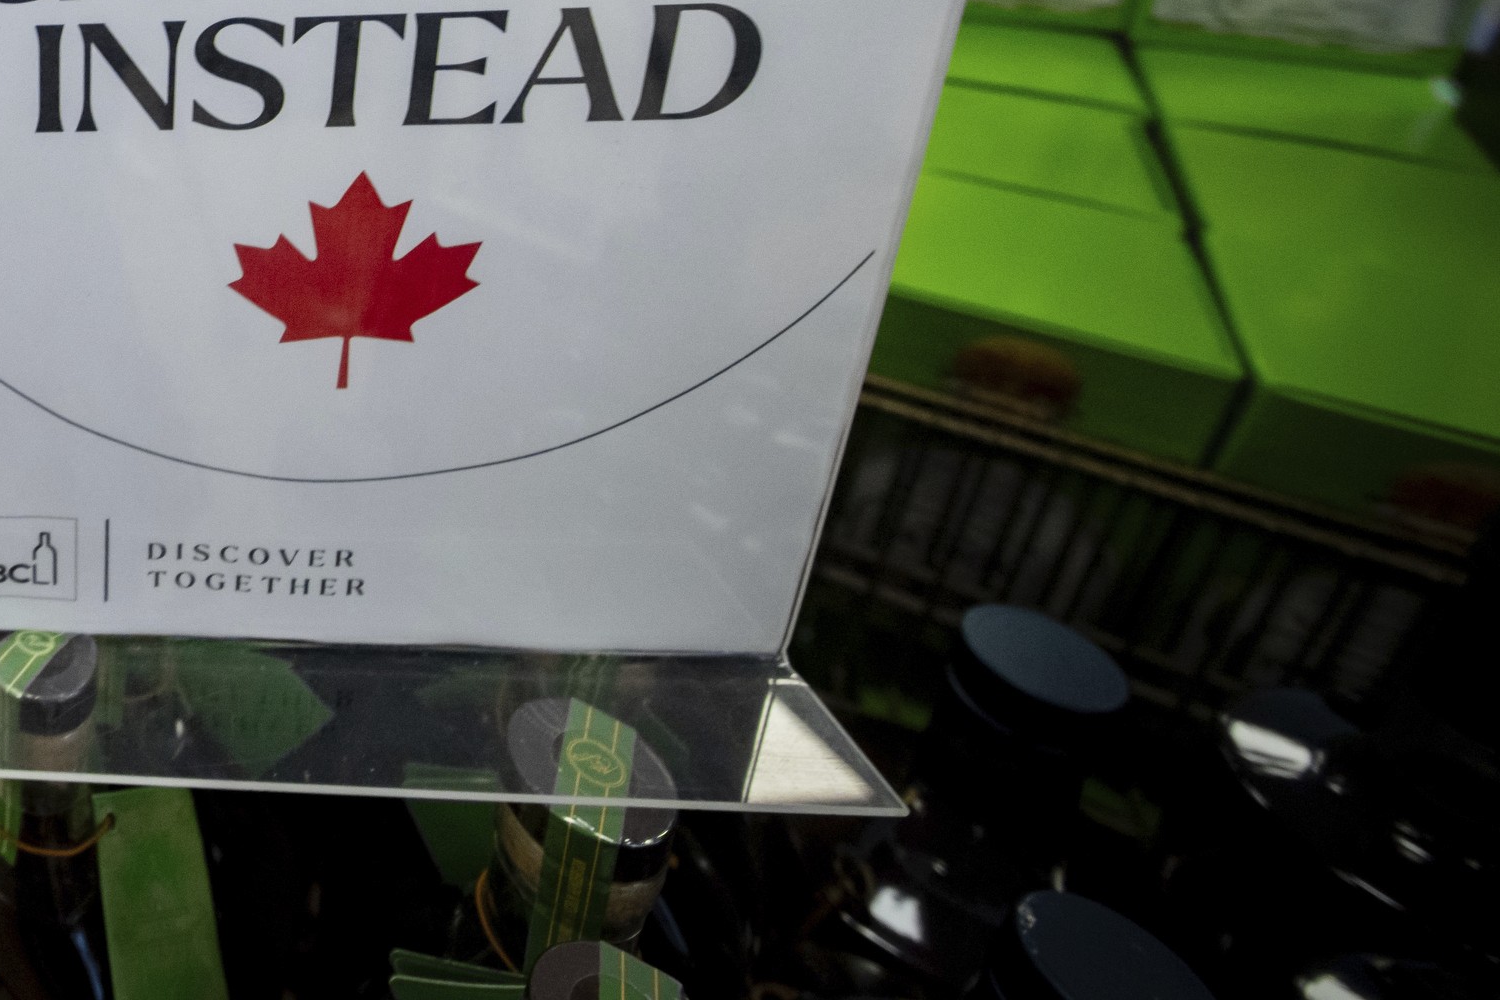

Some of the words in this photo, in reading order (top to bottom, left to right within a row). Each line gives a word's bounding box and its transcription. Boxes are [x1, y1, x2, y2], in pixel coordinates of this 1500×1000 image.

[34, 2, 763, 134] INSTEAD
[147, 541, 355, 569] DISCOVER
[147, 570, 367, 597] TOGETHER
